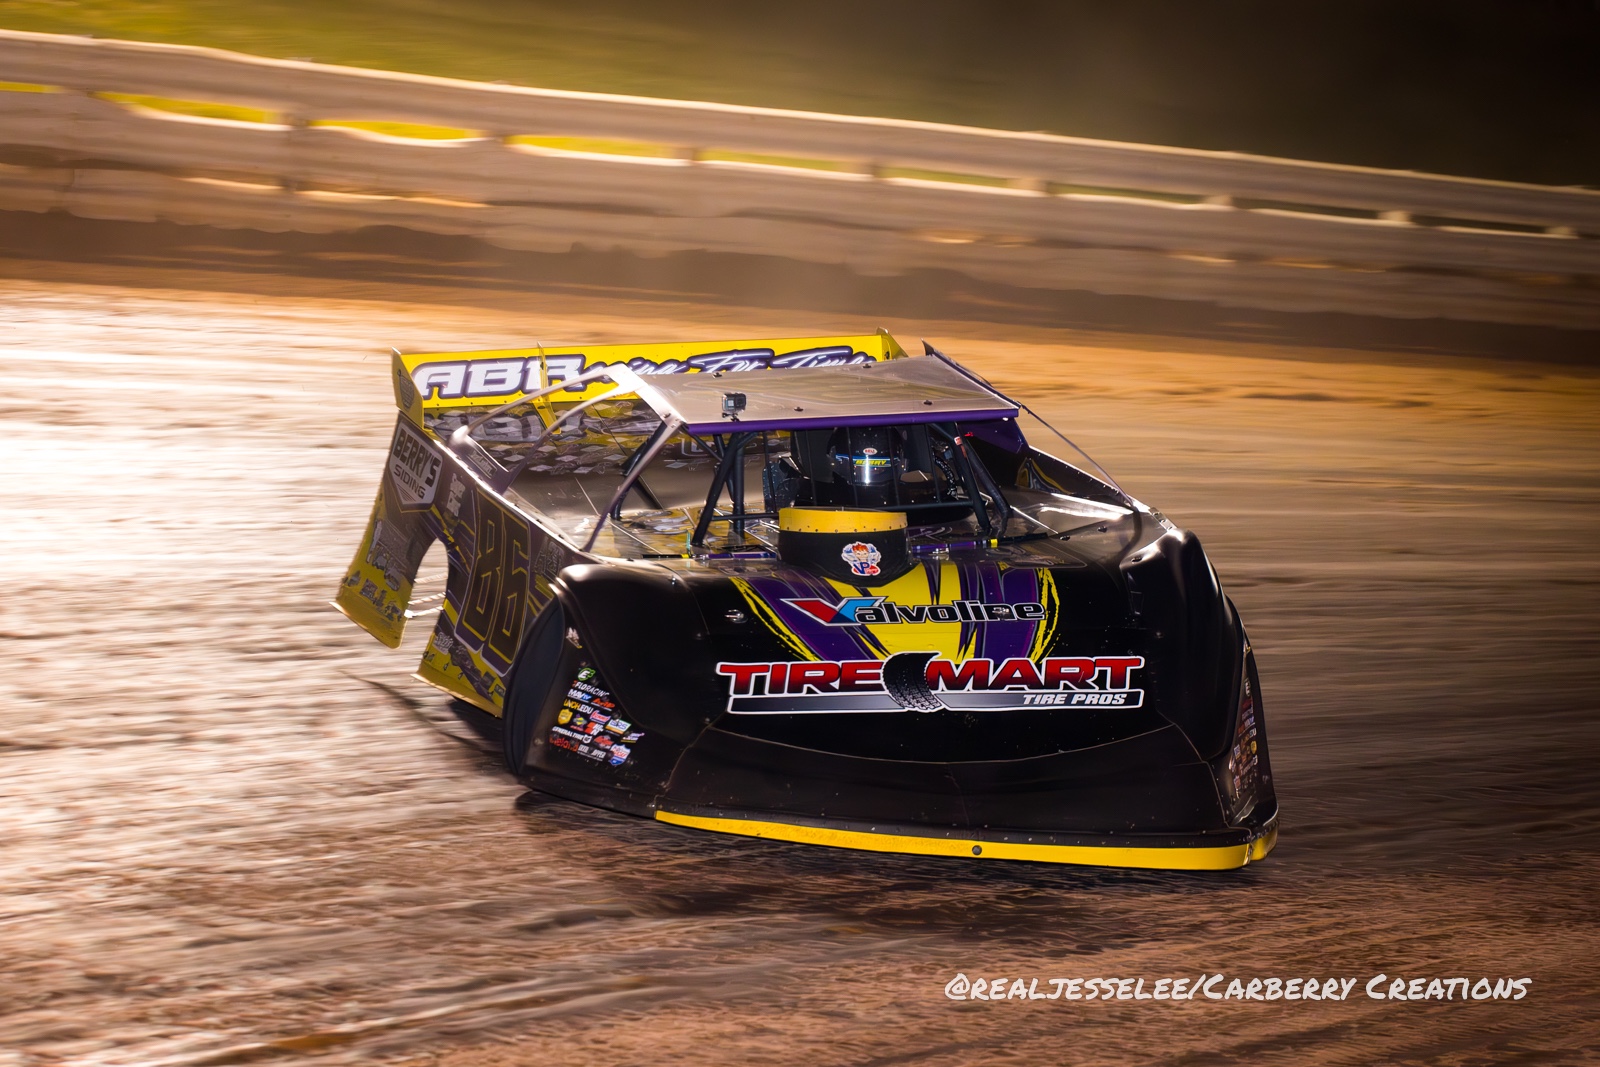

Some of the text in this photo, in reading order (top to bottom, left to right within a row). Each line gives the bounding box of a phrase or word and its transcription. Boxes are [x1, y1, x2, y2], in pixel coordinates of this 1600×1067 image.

[392, 428, 442, 488] BERRY'S
[393, 463, 426, 500] SIDING
[458, 486, 530, 670] 86
[853, 561, 870, 574] VP
[780, 596, 1046, 626] Valvoline
[717, 656, 1145, 695] TIRE MART
[1023, 693, 1126, 706] TIRE PROS
